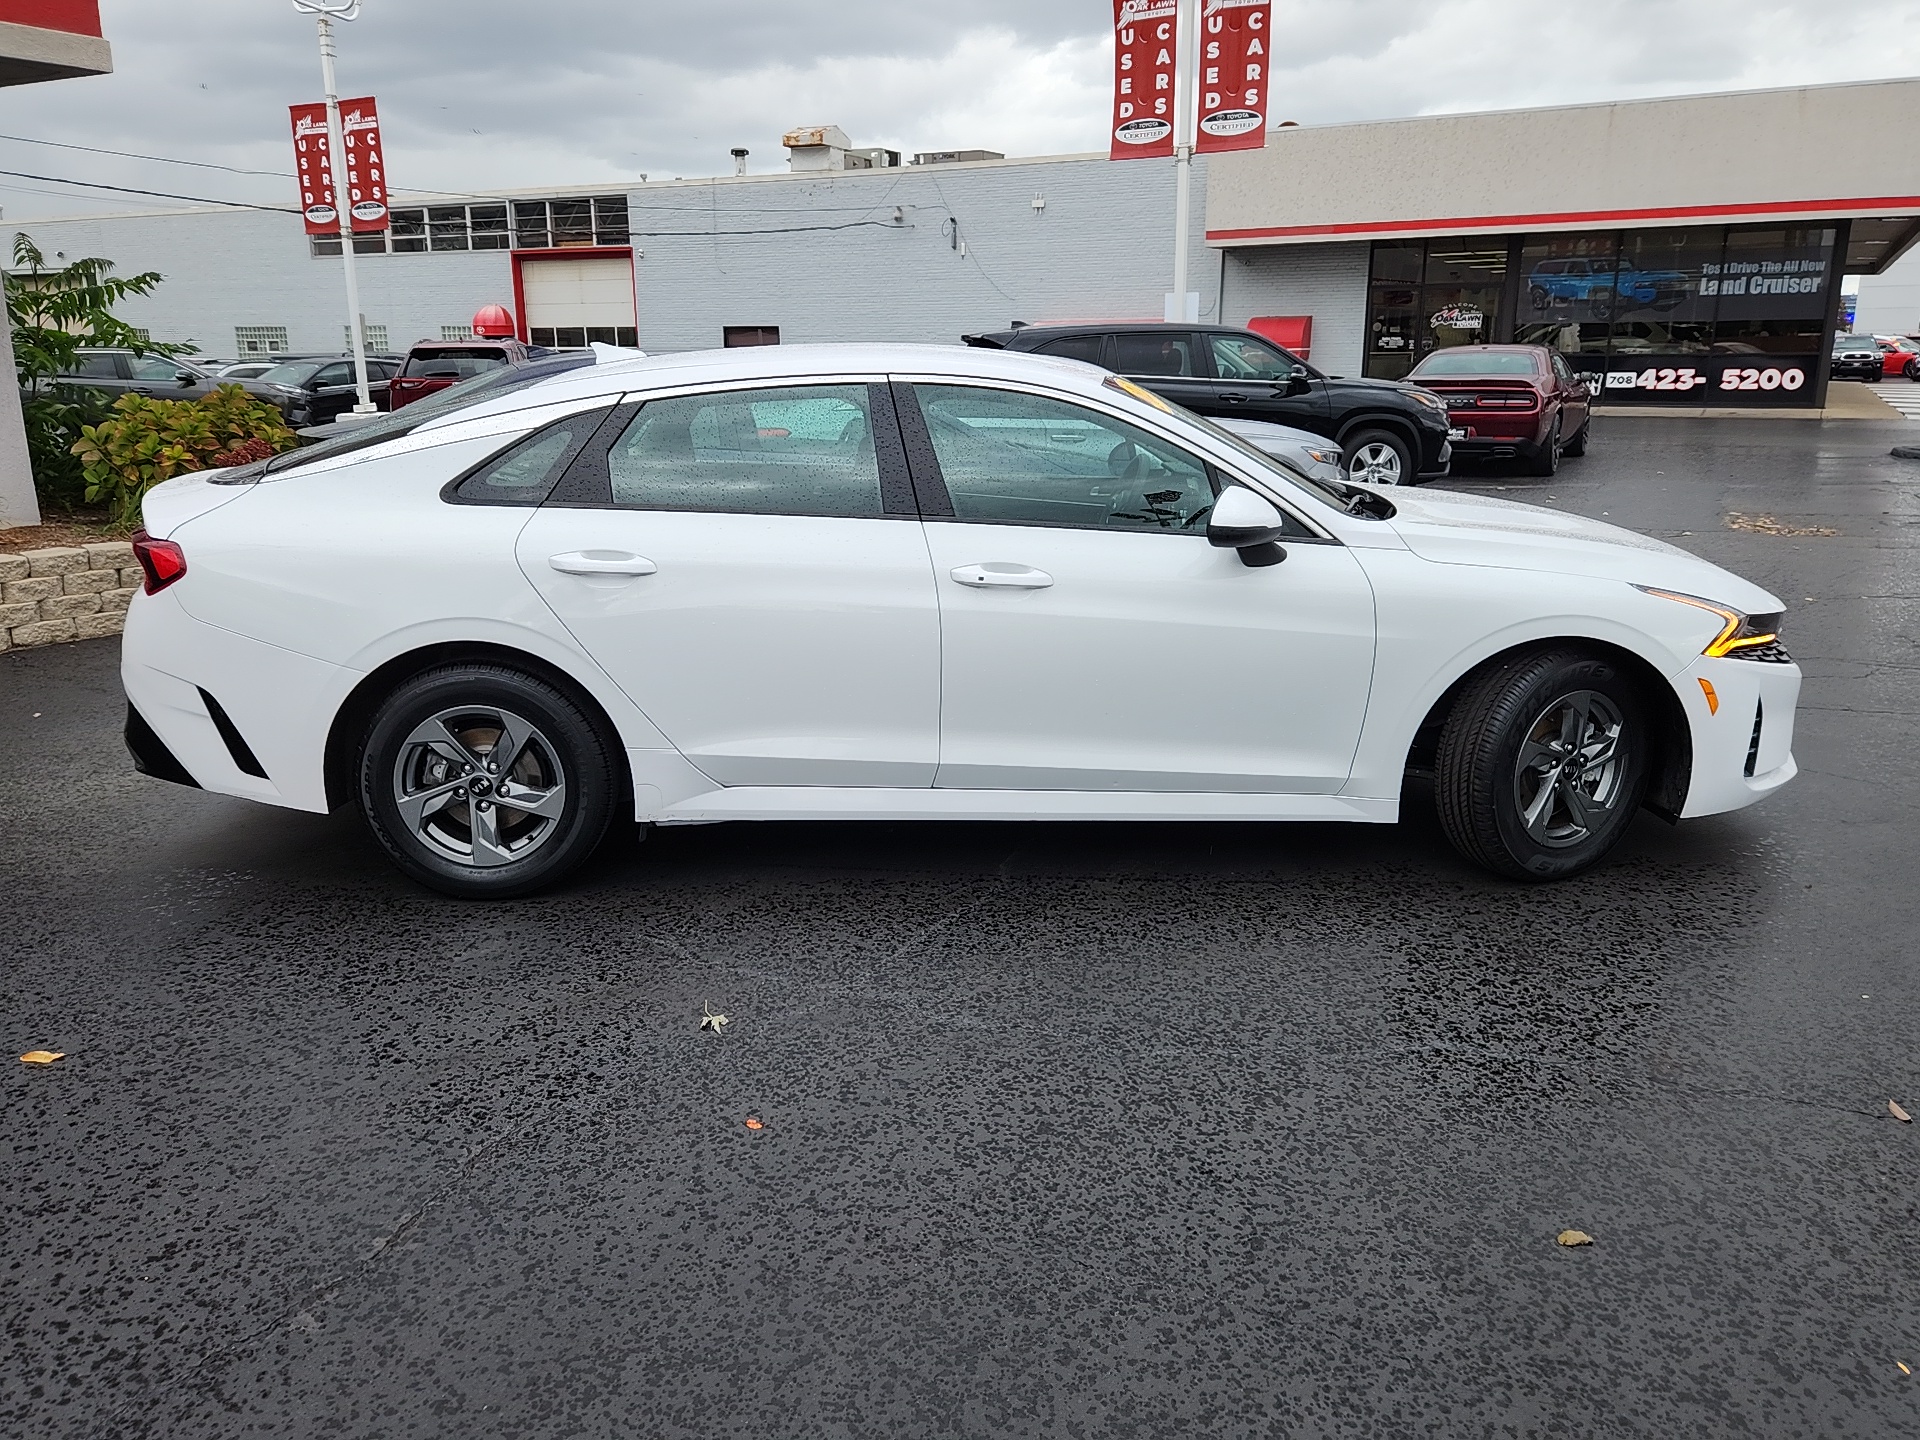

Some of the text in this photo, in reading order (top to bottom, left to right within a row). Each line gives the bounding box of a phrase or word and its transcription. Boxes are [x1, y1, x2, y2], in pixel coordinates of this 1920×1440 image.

[1119, 23, 1171, 119] USED CARS
[1205, 12, 1264, 109] USED CARS
[1123, 130, 1164, 140] CERTIFIED
[1210, 121, 1254, 131] CERTIFIED
[298, 137, 332, 204] USED CARS
[345, 132, 382, 201] USED CARS
[1729, 262, 1759, 274] Drive
[1760, 261, 1782, 273] The
[1783, 260, 1799, 273] All
[1800, 260, 1826, 272] New
[1699, 275, 1821, 296] Land Cruiser
[1442, 302, 1479, 310] WELCOME
[1609, 375, 1633, 385] 708
[1719, 368, 1805, 391] 5200
